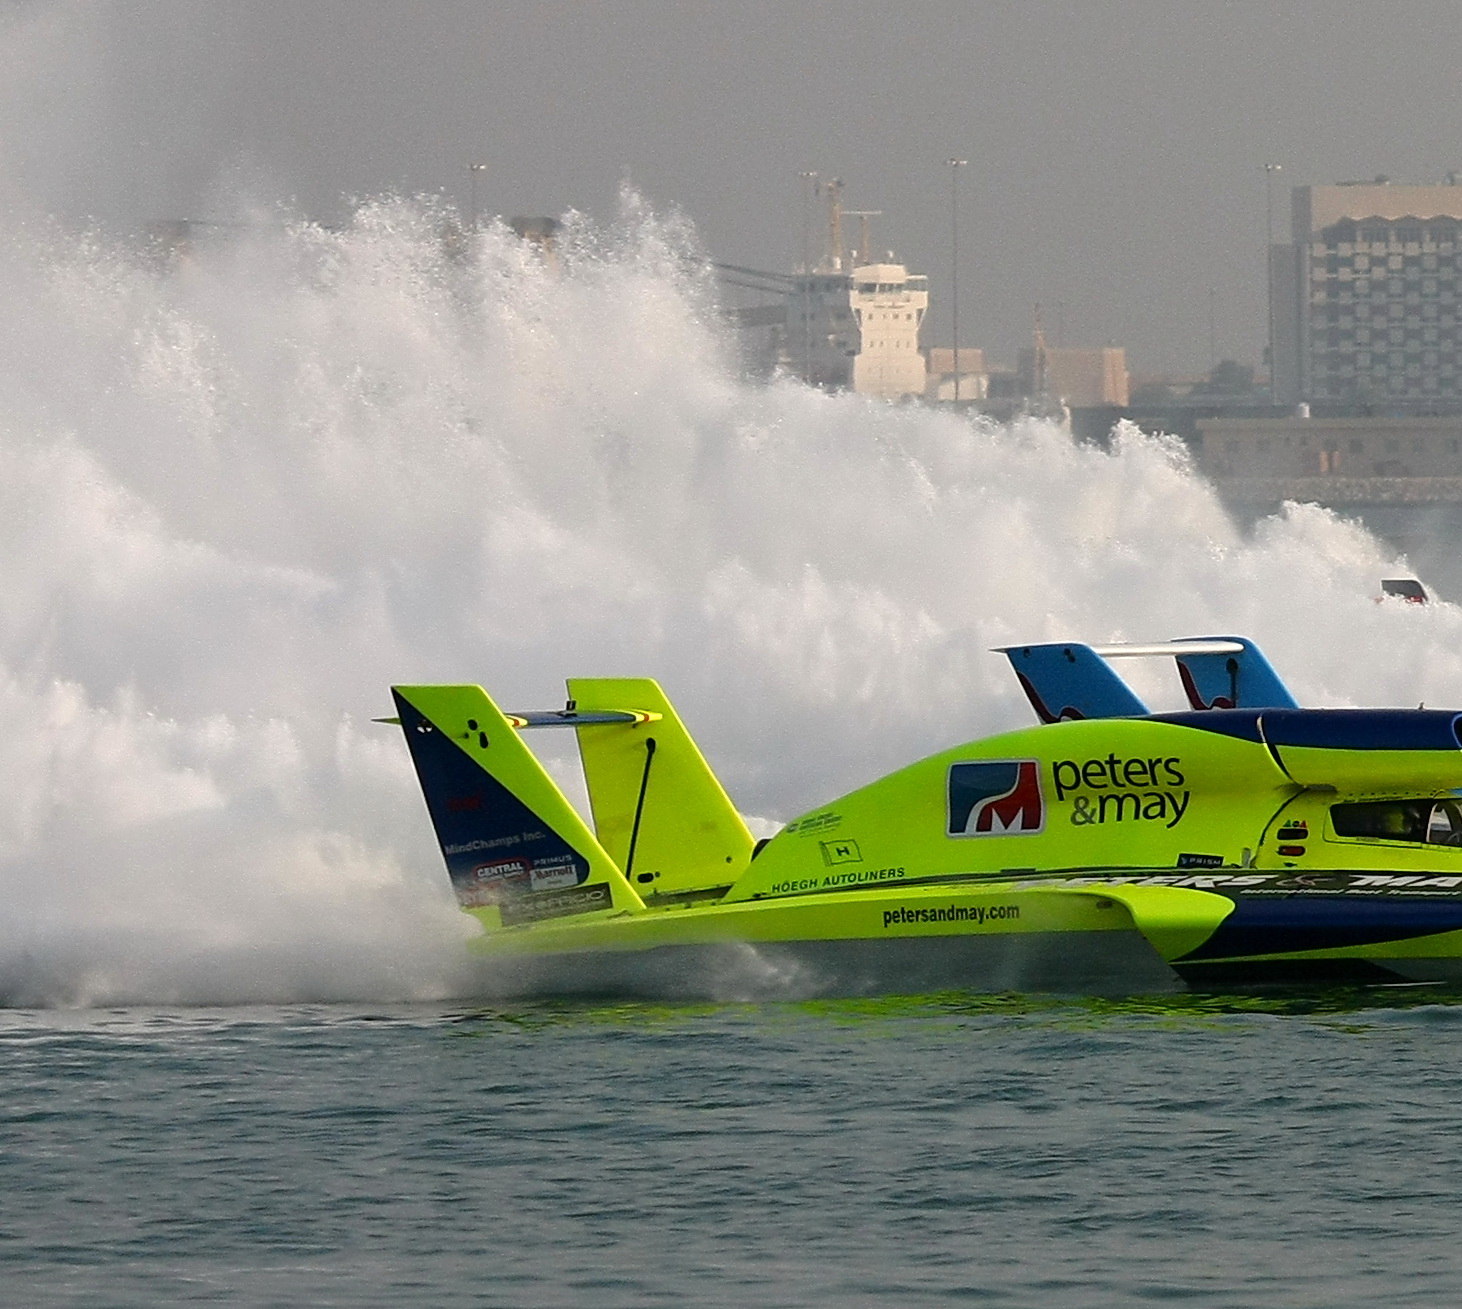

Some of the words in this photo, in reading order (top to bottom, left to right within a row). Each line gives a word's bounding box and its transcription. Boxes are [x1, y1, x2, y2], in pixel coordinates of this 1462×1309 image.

[1053, 753, 1185, 801] peters
[444, 834, 520, 855] MindChamps
[523, 830, 546, 843] Inc.
[477, 862, 524, 878] CENTRAL
[822, 867, 906, 888] AUTOLINERS
[883, 904, 1020, 928] petersandmay.com
